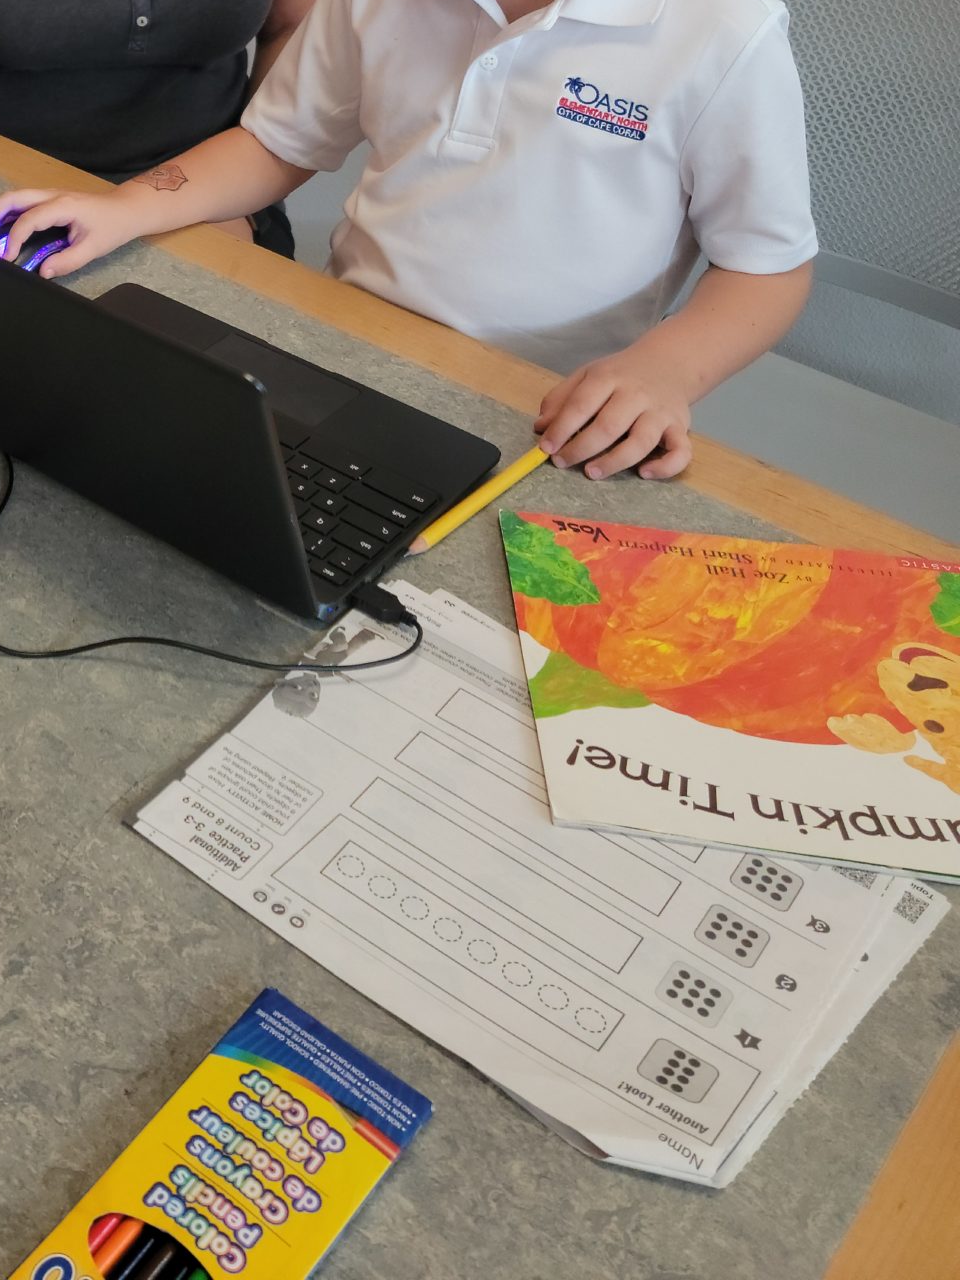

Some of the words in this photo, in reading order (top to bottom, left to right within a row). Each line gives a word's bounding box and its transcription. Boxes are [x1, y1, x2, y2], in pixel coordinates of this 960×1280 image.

[559, 97, 616, 123] ELEMENTARY
[617, 116, 647, 132] NORTH
[574, 83, 649, 122] OASIS
[559, 108, 576, 118] CITY
[577, 114, 588, 123] OF
[589, 119, 612, 131] CAPE
[613, 126, 641, 140] CORAL
[618, 540, 694, 557] Halpern
[702, 550, 752, 564] Shari
[706, 564, 745, 579] Hall
[753, 570, 789, 584] Zoe
[566, 738, 734, 822] Time!
[191, 802, 215, 818] and
[226, 788, 260, 810] ACTIVITY
[184, 815, 205, 831] 3-3
[215, 818, 224, 826] 8
[261, 810, 284, 826] HOME
[208, 831, 251, 863] Practice
[225, 824, 260, 851] Count
[189, 835, 242, 872] Additional
[781, 976, 794, 988] 2
[259, 1022, 285, 1041] QUALITY
[272, 1010, 301, 1032] ESCOLAR
[285, 1038, 310, 1059] SCHOOL
[300, 1030, 326, 1050] CALIDAD
[330, 1052, 352, 1069] PUNTA
[350, 1066, 365, 1079] CON
[313, 1059, 364, 1099] PRE-SHARPENED
[239, 1070, 308, 1126] Color
[361, 1084, 391, 1111] TOXIQUES
[392, 1097, 402, 1107] ES
[618, 1081, 654, 1106] Look!
[367, 1100, 402, 1128] NON-TOXIC
[391, 1108, 407, 1121] NON
[401, 1105, 413, 1114] NO
[655, 1102, 709, 1134] Another
[188, 1105, 284, 1182] couleur
[229, 1092, 325, 1175] Lápices
[307, 1116, 345, 1153] de
[658, 1133, 704, 1170] Name
[185, 1135, 289, 1226] Crayons
[169, 1165, 263, 1249] Pencils
[282, 1175, 322, 1213] de
[142, 1182, 247, 1274] Colored
